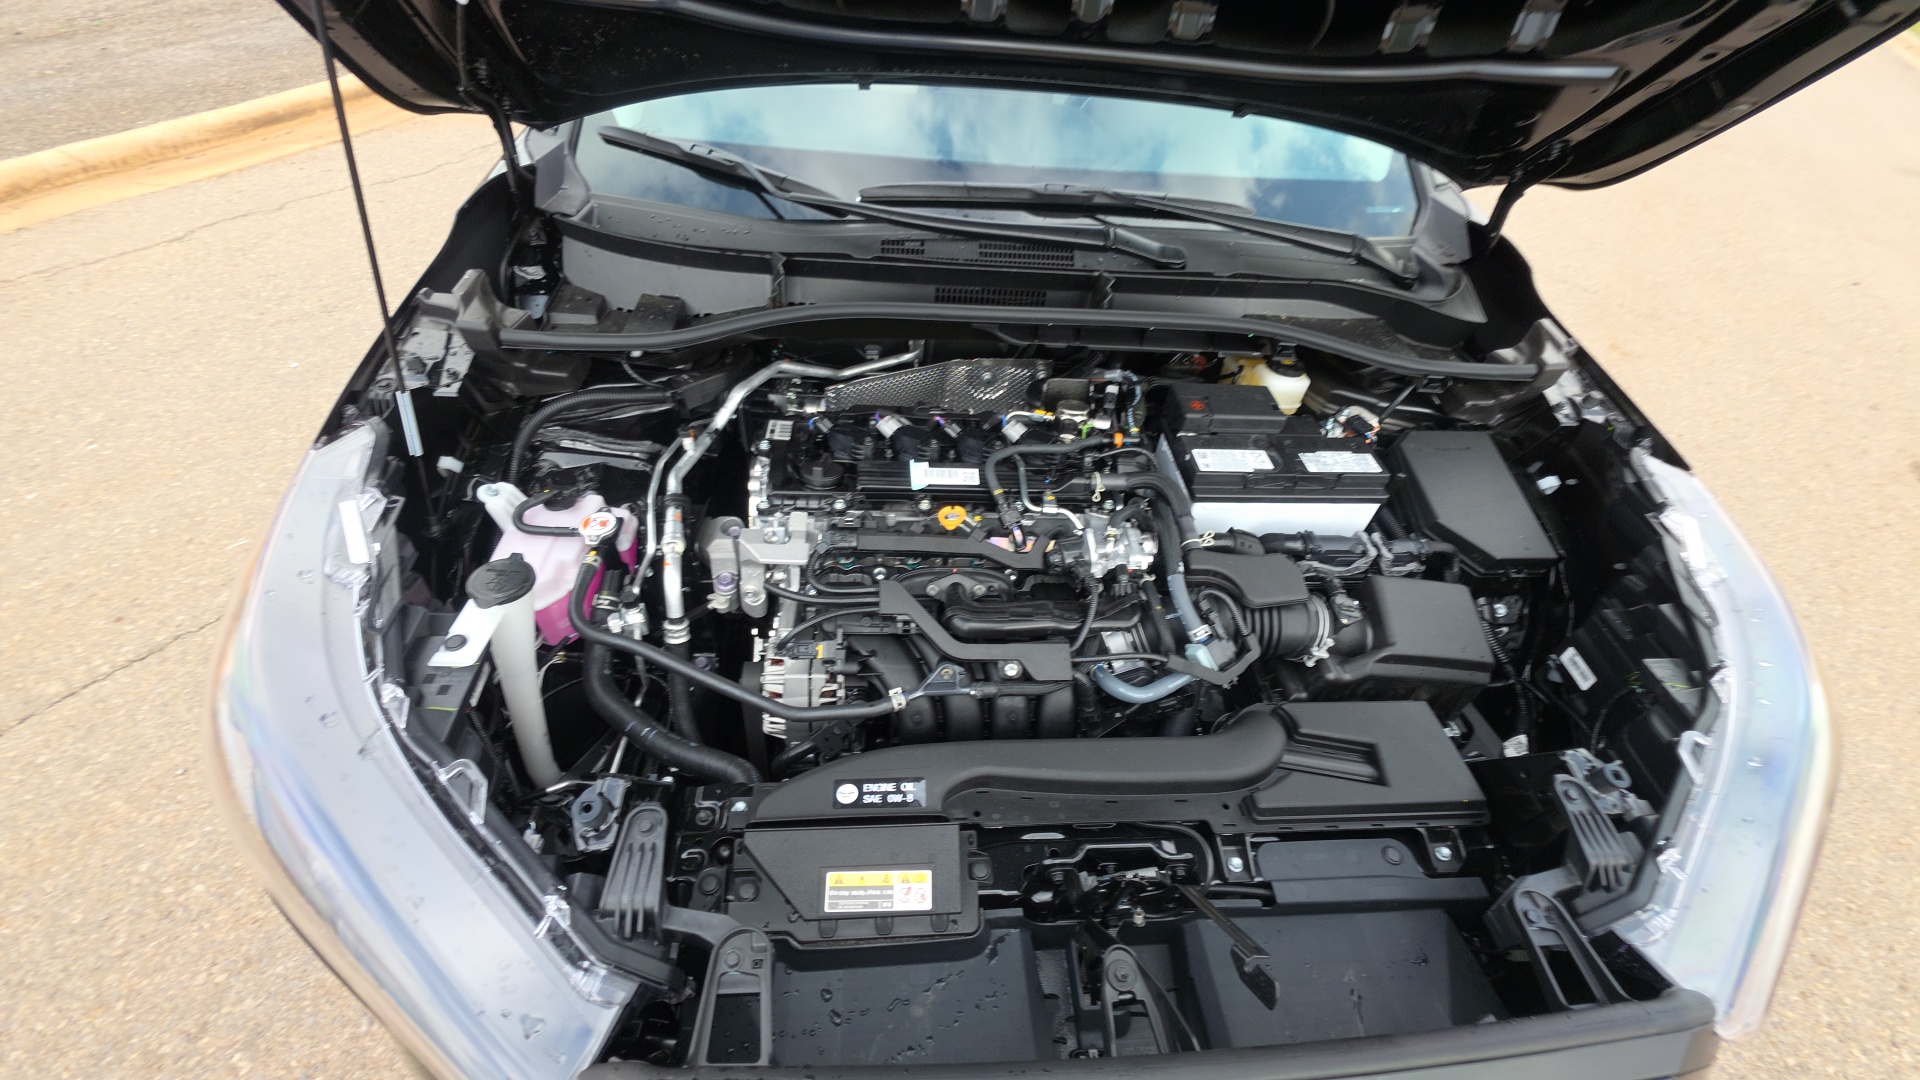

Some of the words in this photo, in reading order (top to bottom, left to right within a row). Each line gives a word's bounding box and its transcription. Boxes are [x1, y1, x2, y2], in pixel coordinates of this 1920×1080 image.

[862, 782, 897, 793] ENGINE
[900, 782, 917, 792] OIL
[862, 794, 883, 804] SAE
